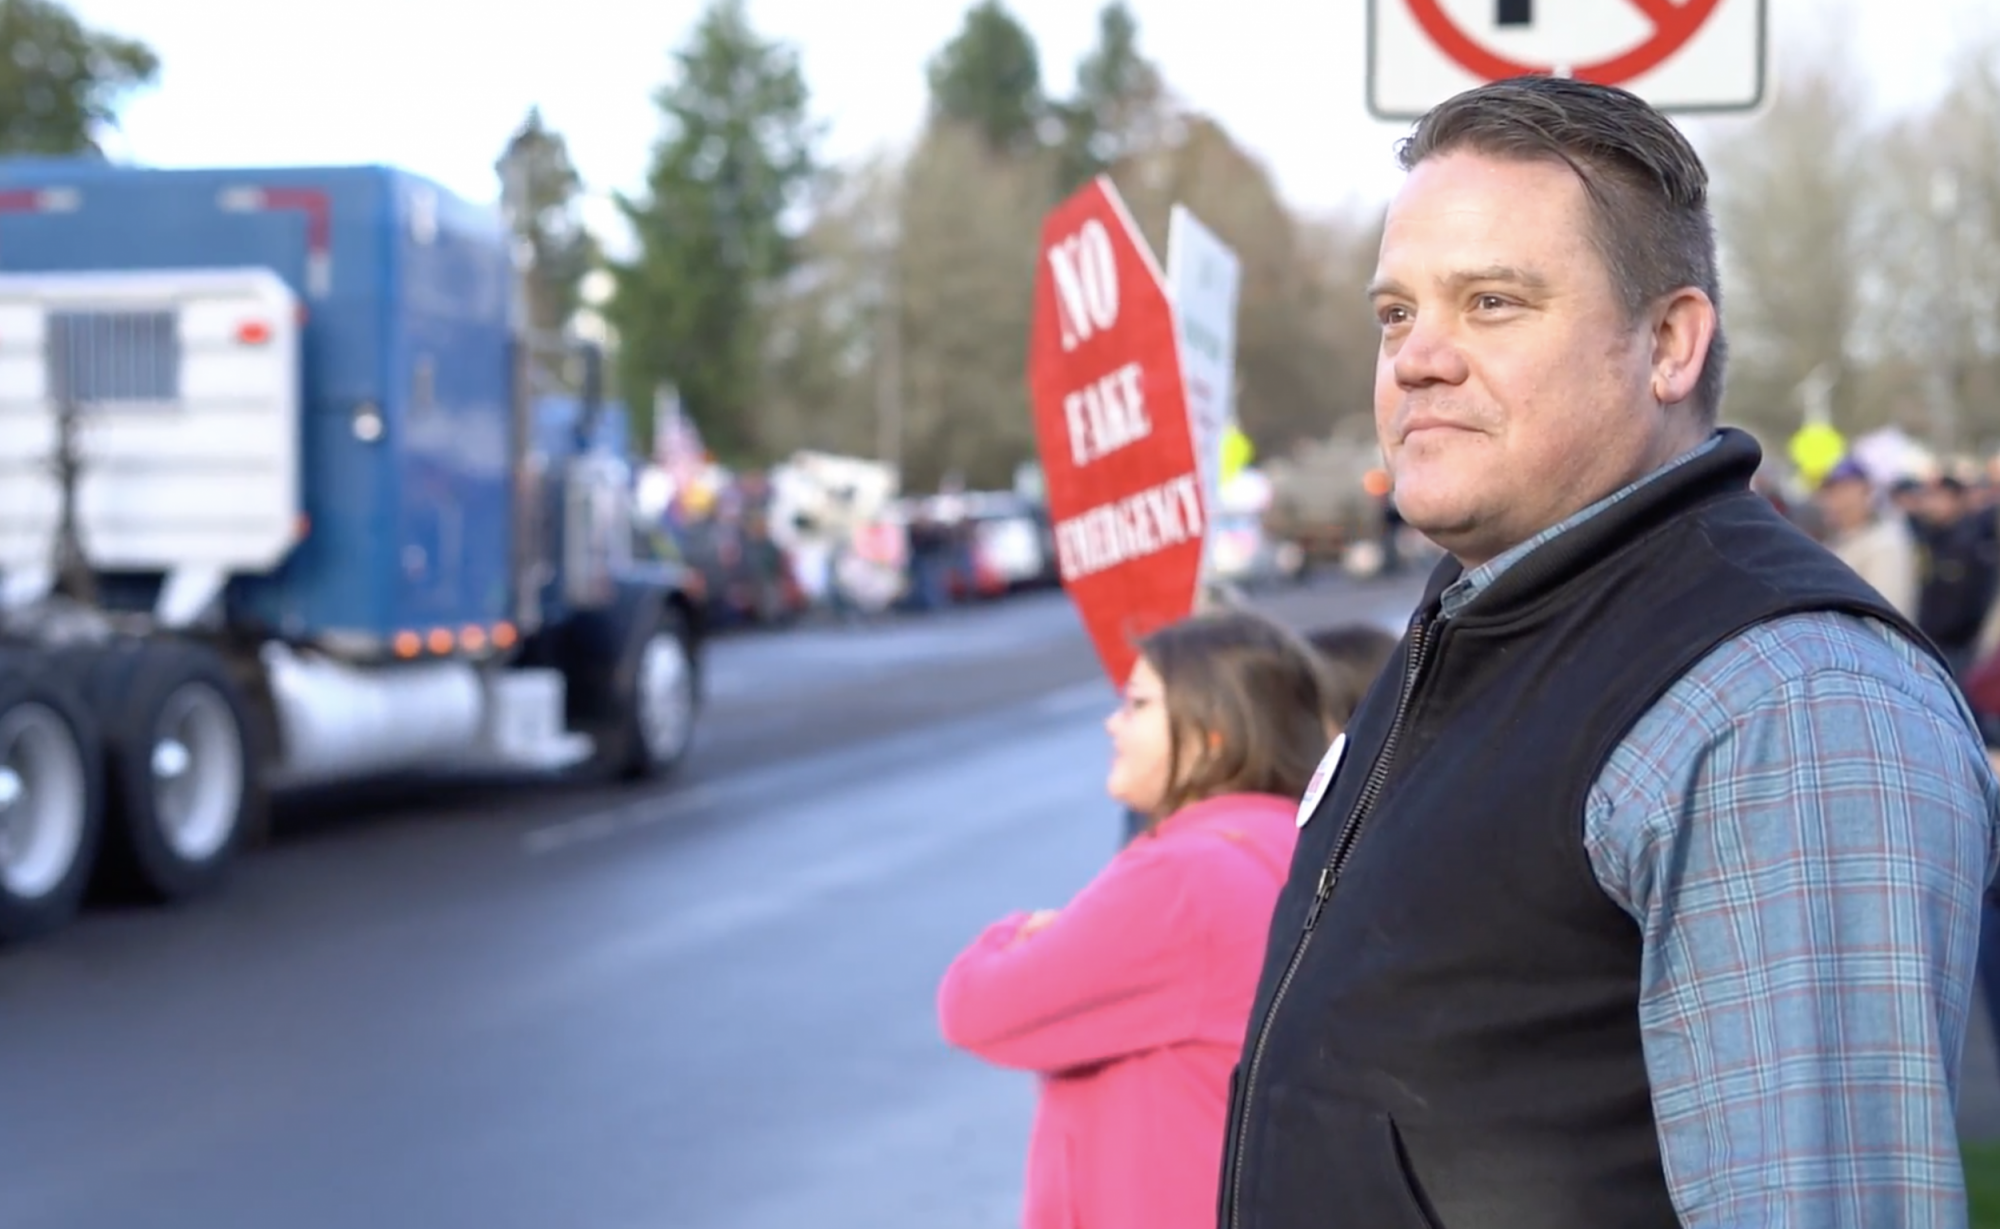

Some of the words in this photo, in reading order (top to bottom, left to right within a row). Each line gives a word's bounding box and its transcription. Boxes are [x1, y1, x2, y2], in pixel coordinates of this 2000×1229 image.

[1048, 218, 1120, 351] NO
[1063, 363, 1151, 467] FAKE
[1055, 472, 1204, 581] EMERGENCY
